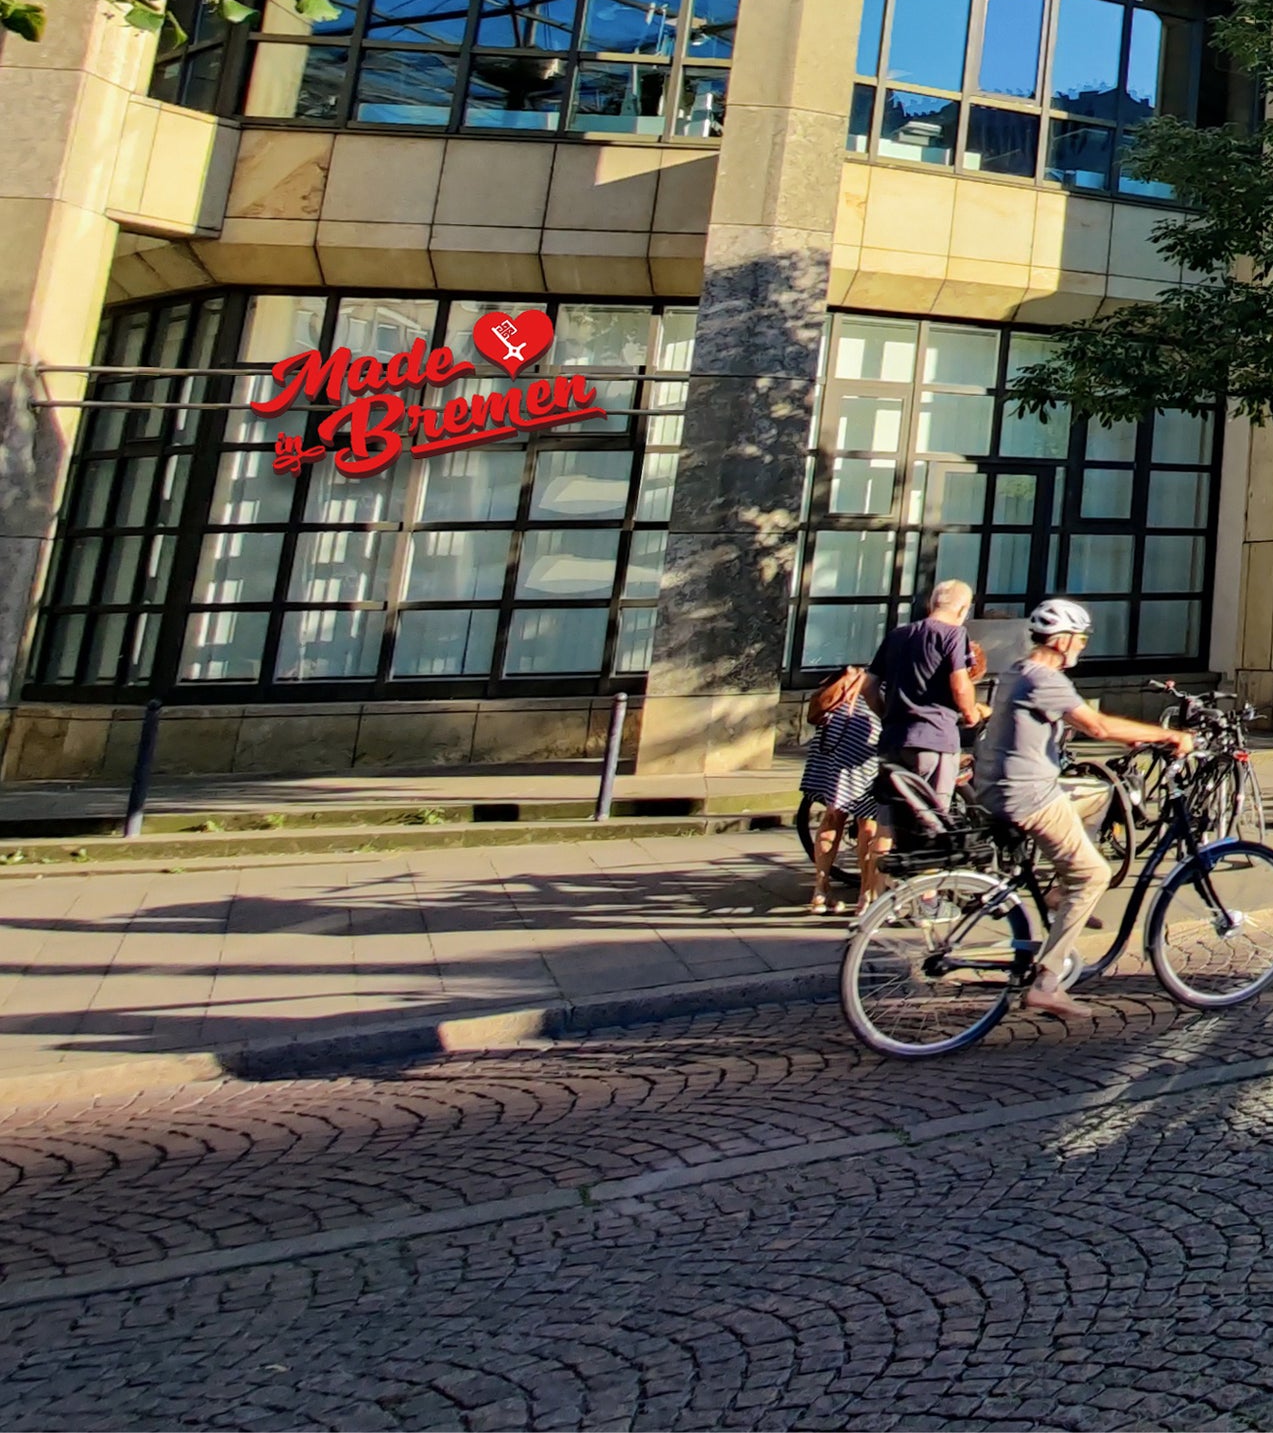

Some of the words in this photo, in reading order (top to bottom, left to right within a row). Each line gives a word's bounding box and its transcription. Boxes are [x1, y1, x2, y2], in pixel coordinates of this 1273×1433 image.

[250, 337, 475, 418] Made
[272, 432, 326, 477] in
[317, 374, 607, 479] Bremen
